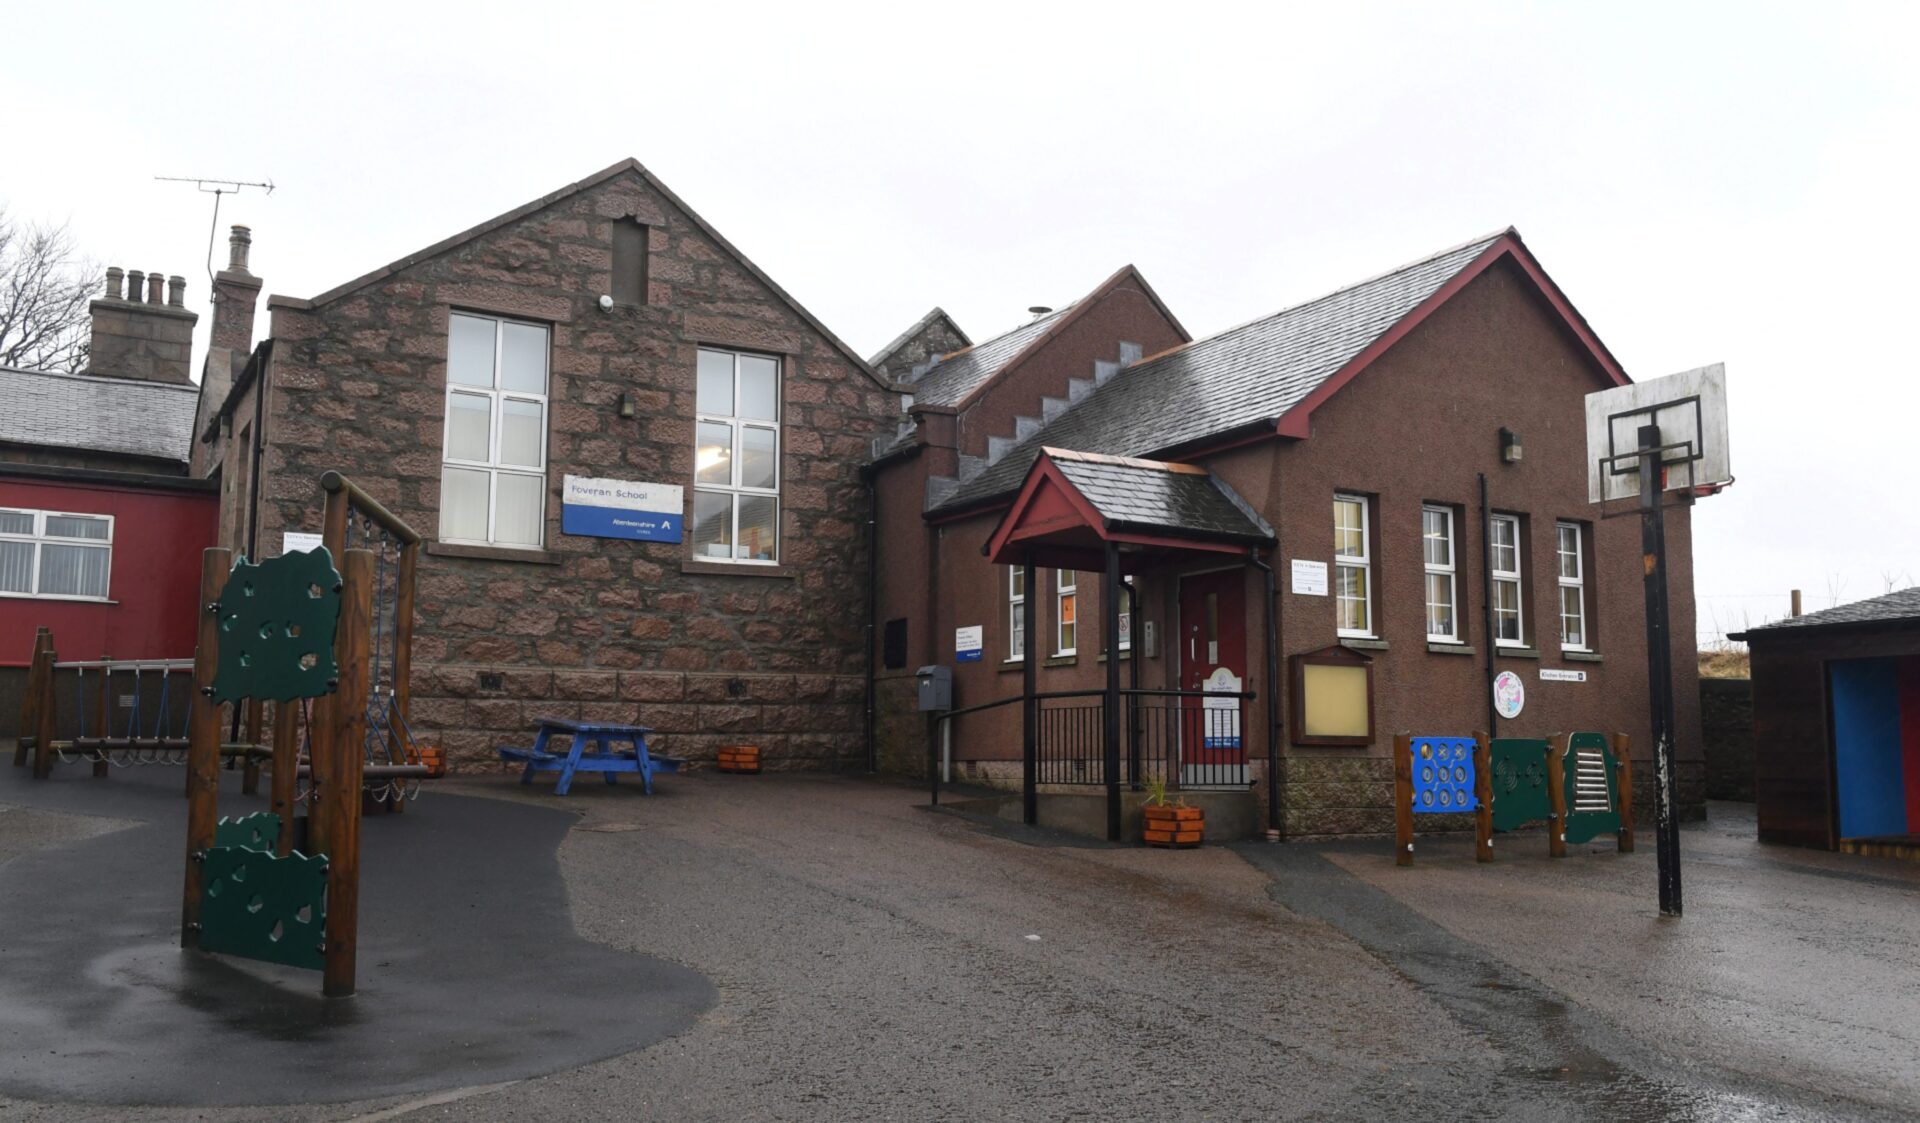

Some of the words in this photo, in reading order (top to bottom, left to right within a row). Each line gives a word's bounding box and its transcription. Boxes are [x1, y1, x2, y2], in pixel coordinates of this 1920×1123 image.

[571, 484, 612, 498] Foveran
[616, 489, 648, 500] School
[612, 518, 656, 529] Aberdeenshire
